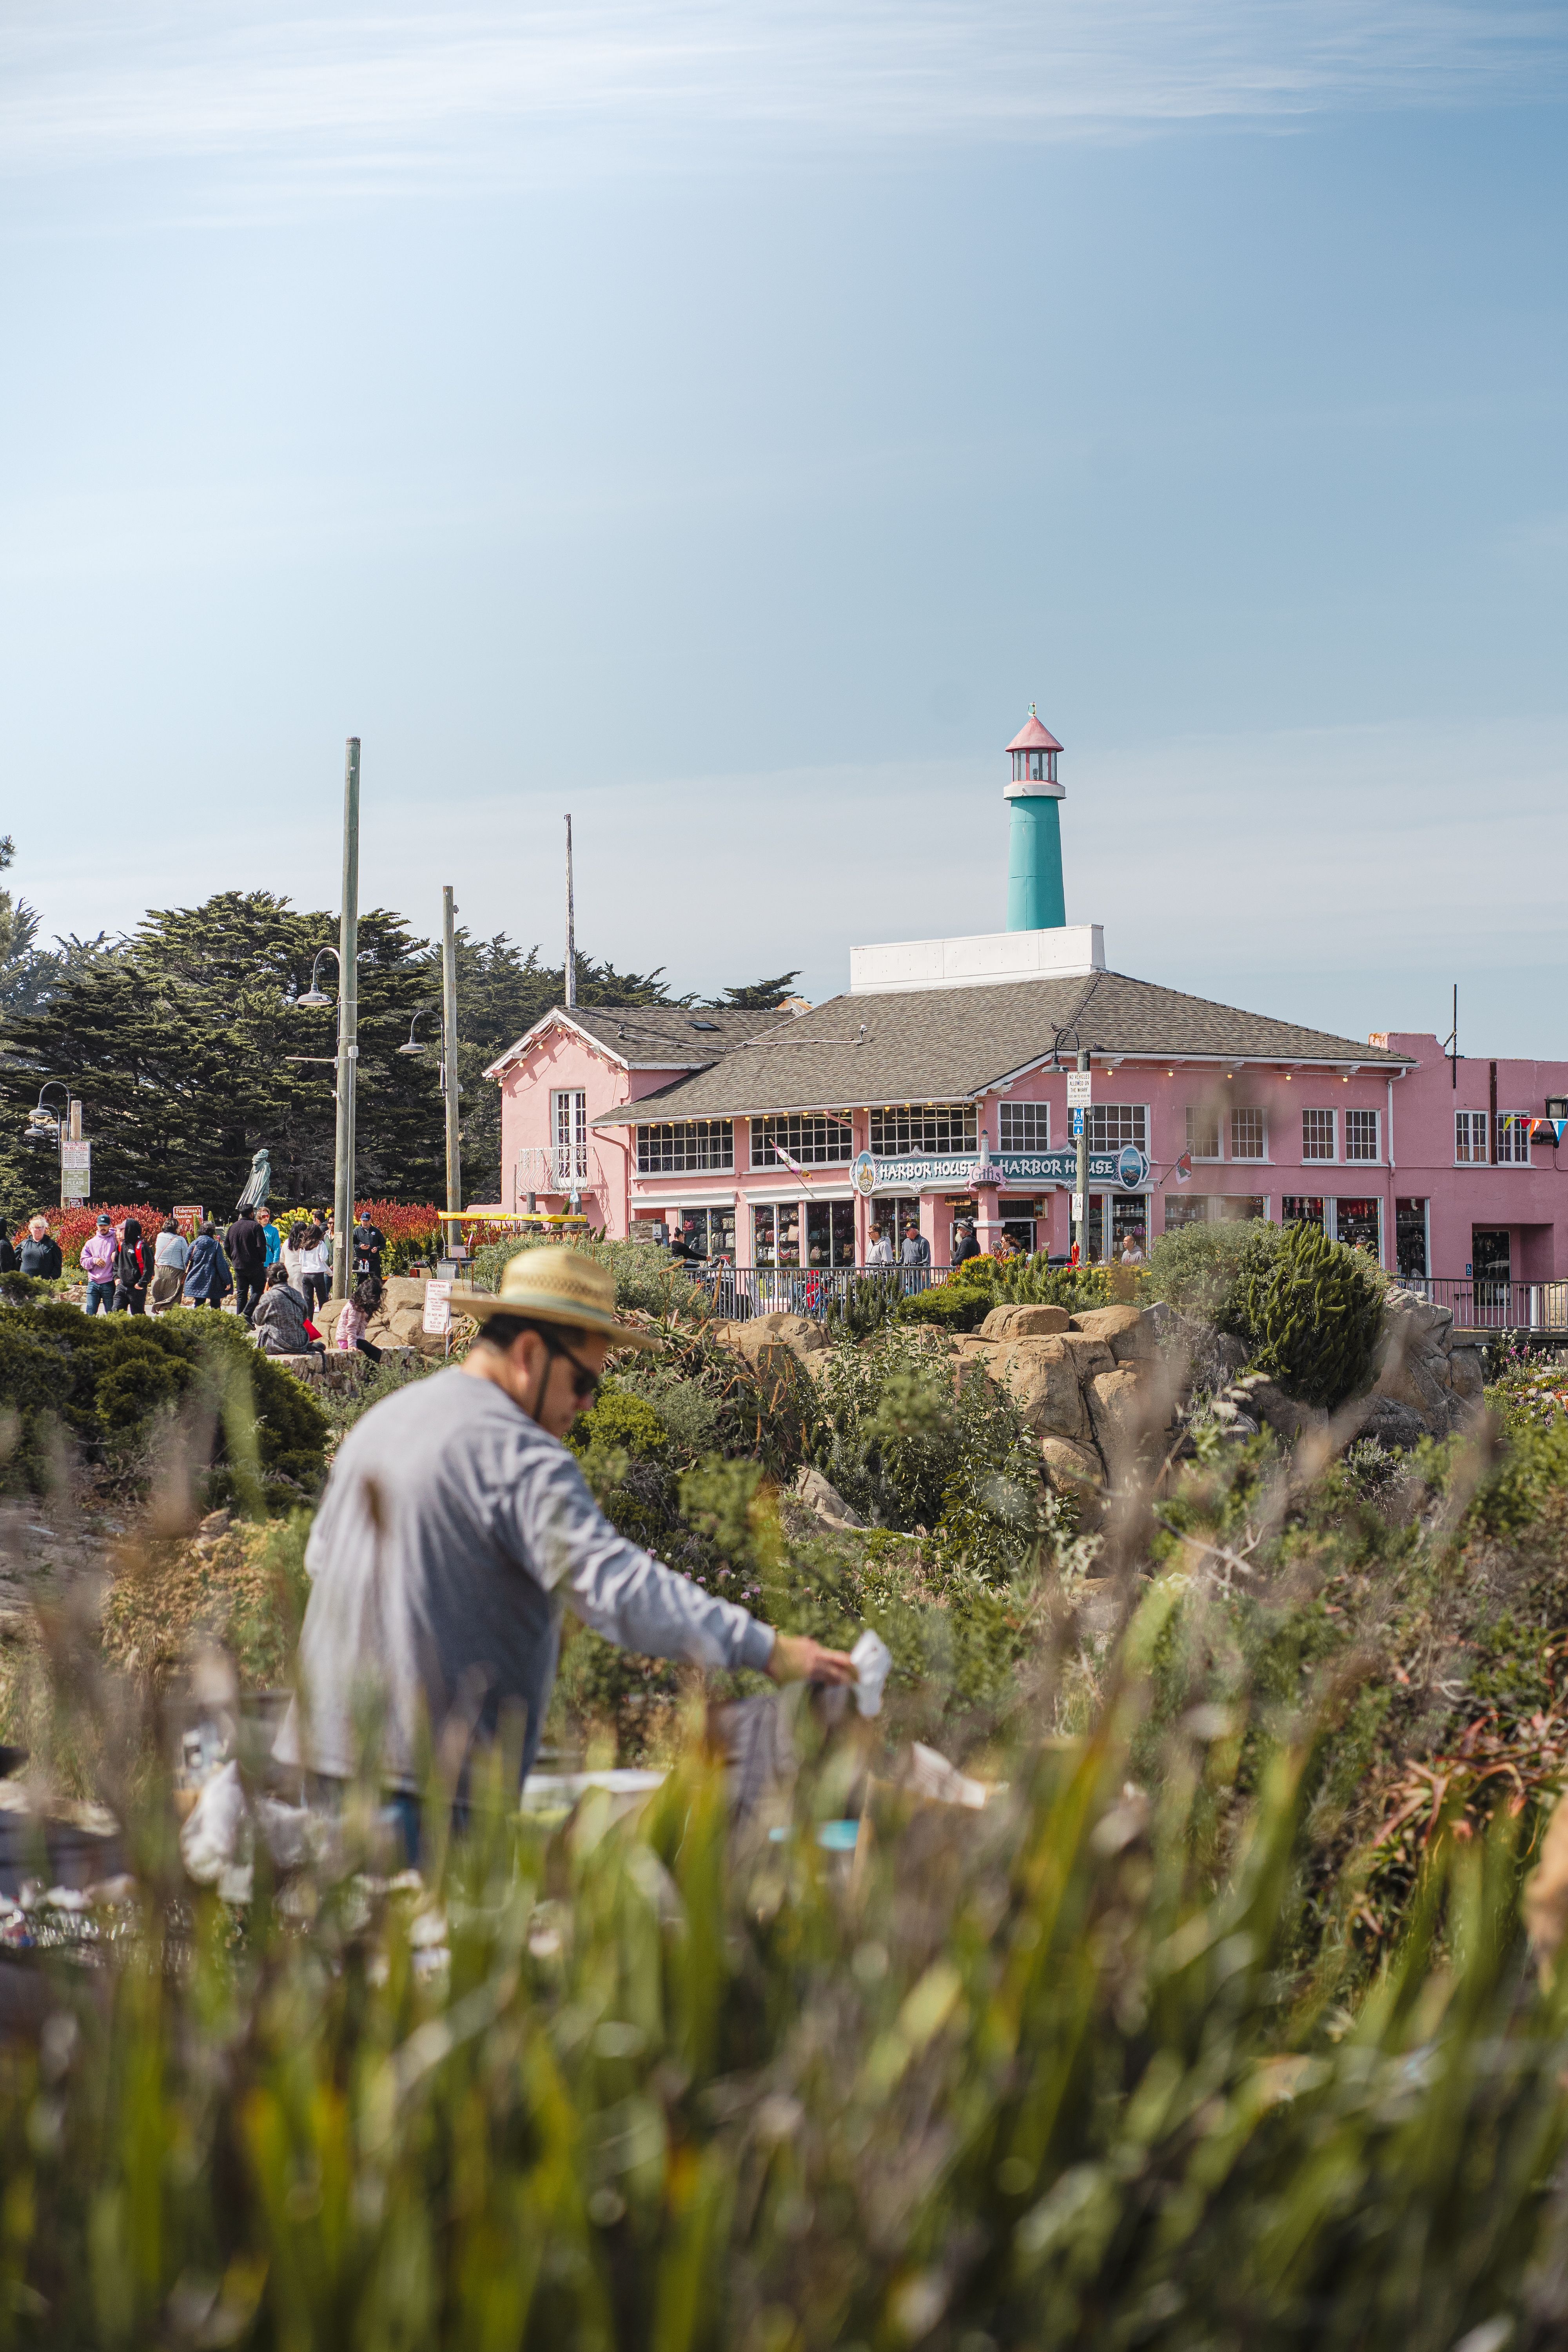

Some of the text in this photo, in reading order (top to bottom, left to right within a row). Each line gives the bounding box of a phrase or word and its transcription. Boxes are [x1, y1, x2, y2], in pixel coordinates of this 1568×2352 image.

[880, 1161, 932, 1180] HARBOR
[972, 1166, 1001, 1181] Gifts
[999, 1159, 1114, 1176] HARBOR HUSE
